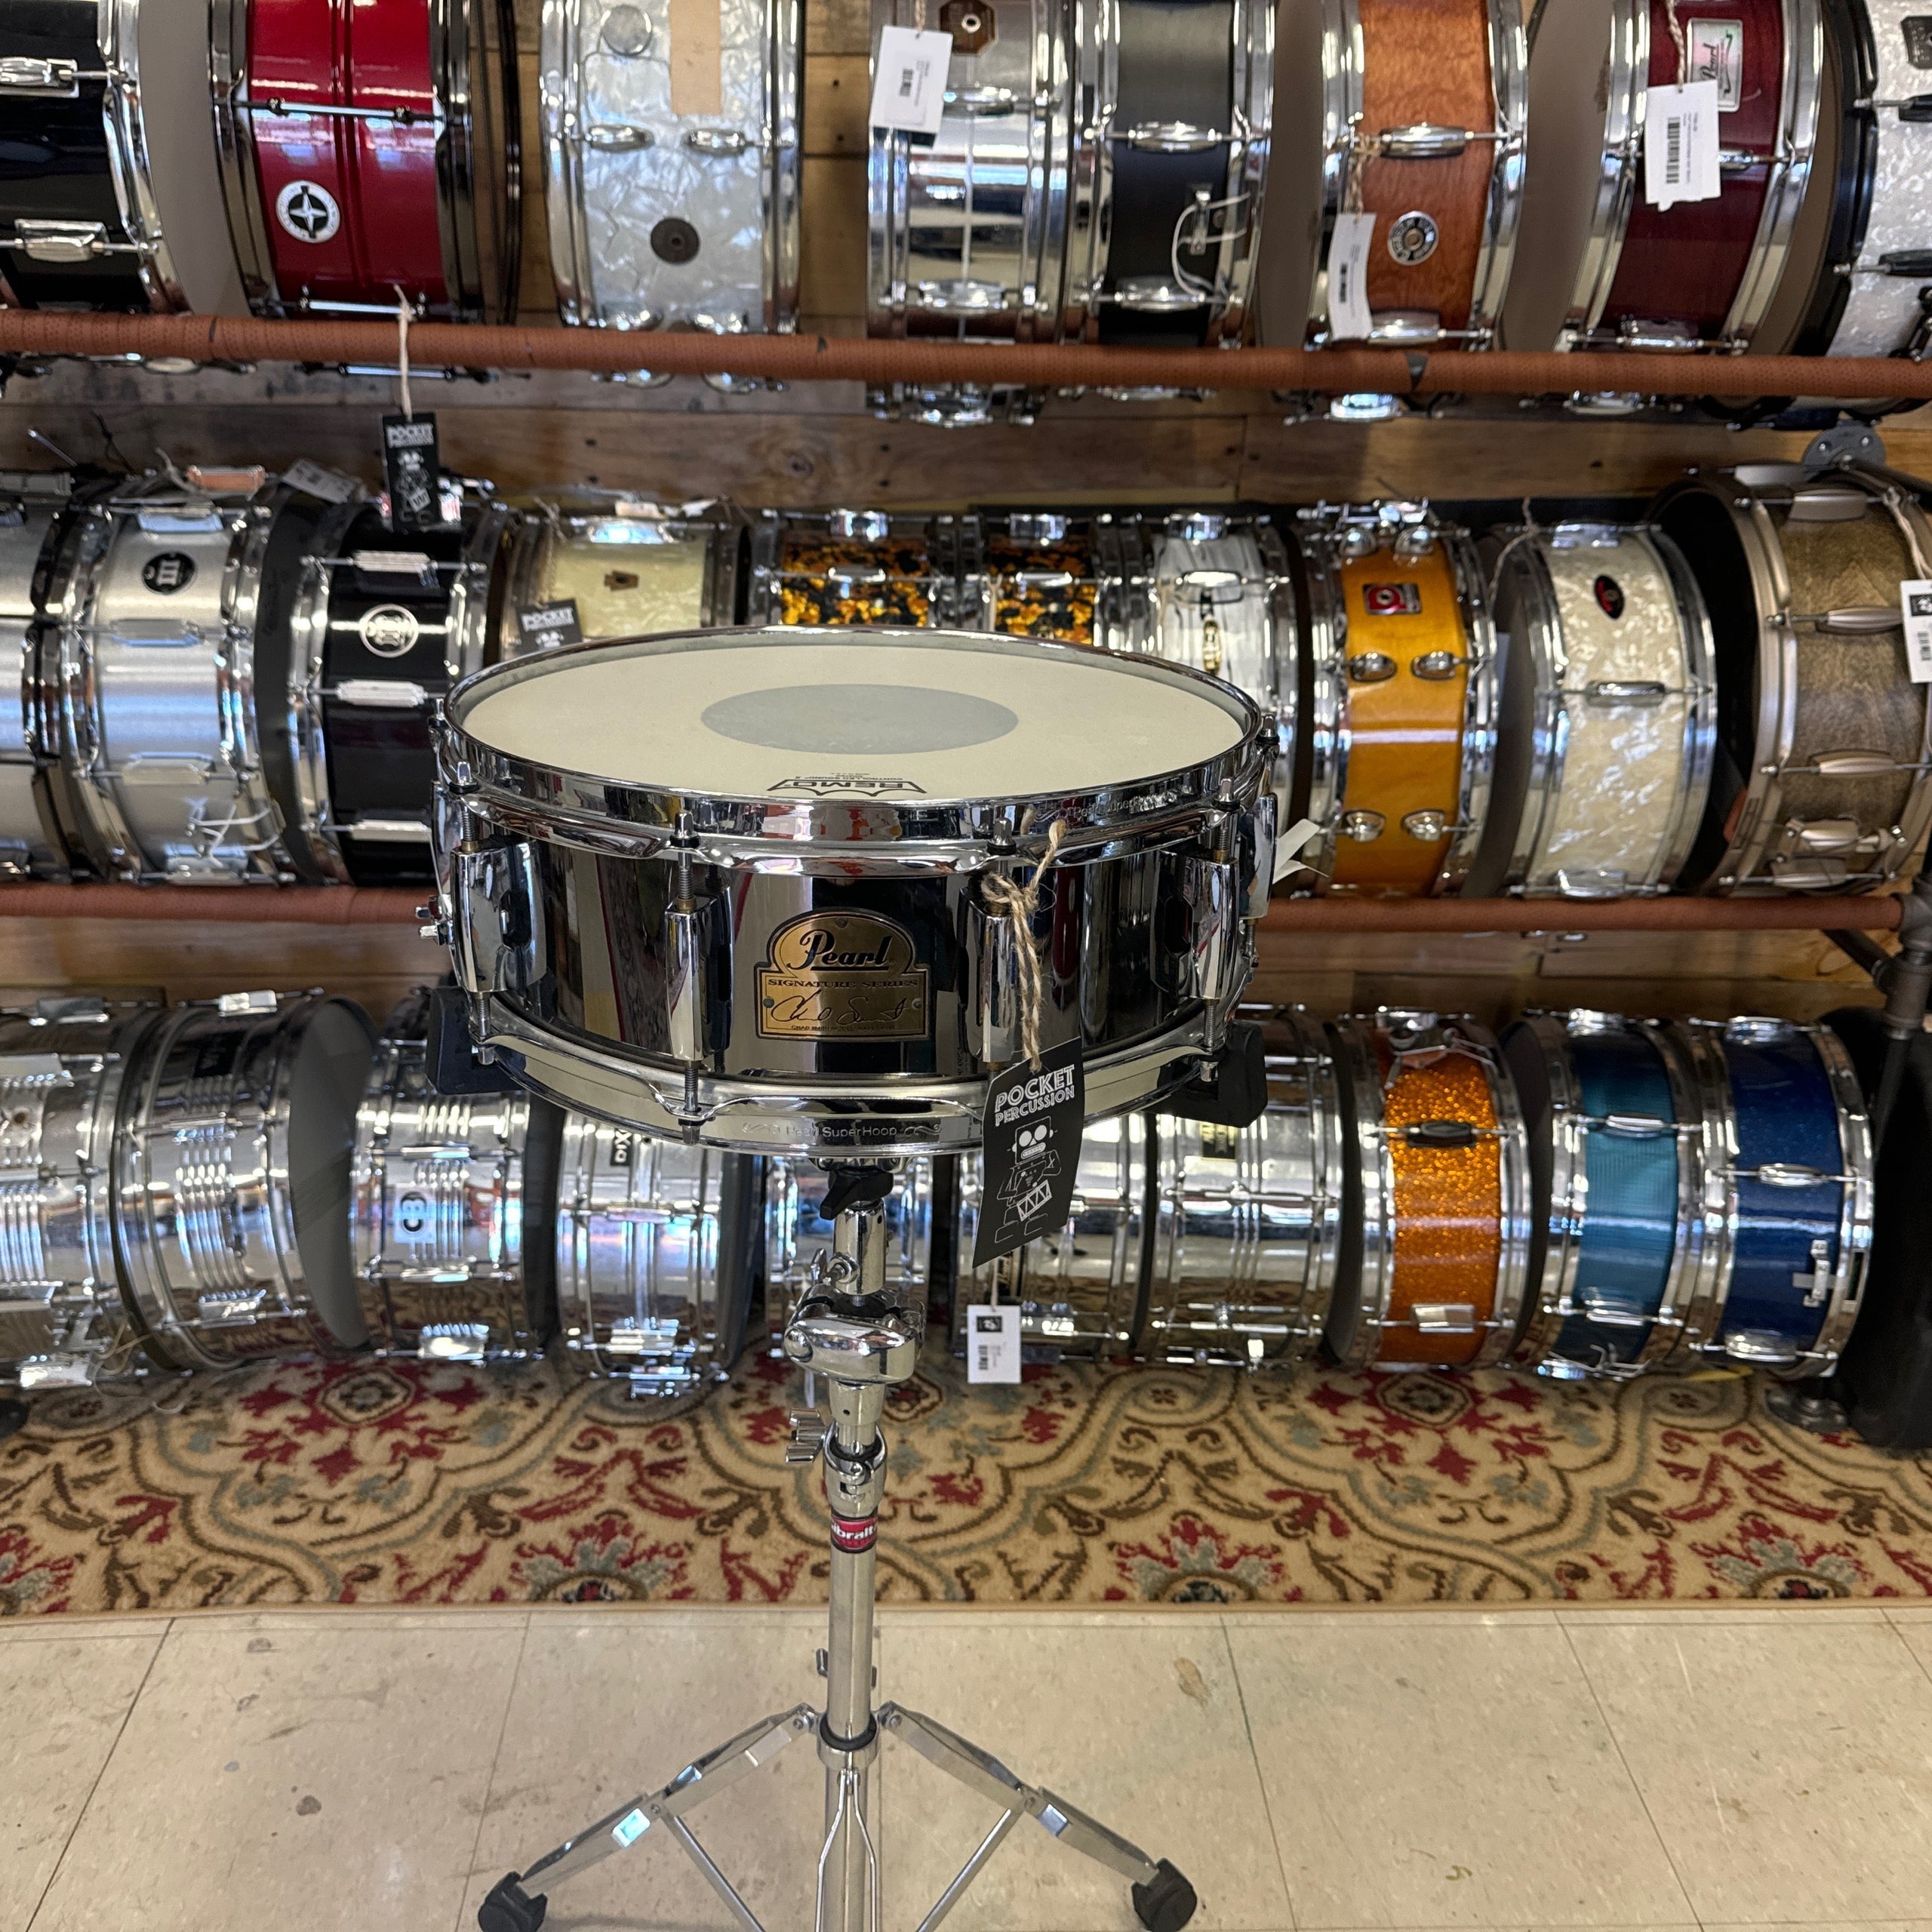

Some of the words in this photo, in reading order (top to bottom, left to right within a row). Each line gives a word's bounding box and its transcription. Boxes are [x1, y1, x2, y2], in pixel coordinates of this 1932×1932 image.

[786, 929, 894, 971] Pearl
[768, 979, 856, 989] SIGNATURE
[862, 979, 918, 989] SERIES
[994, 1063, 1075, 1113] POCKET
[995, 1084, 1075, 1128] PERCUSSION
[831, 1522, 875, 1540] ibralt
